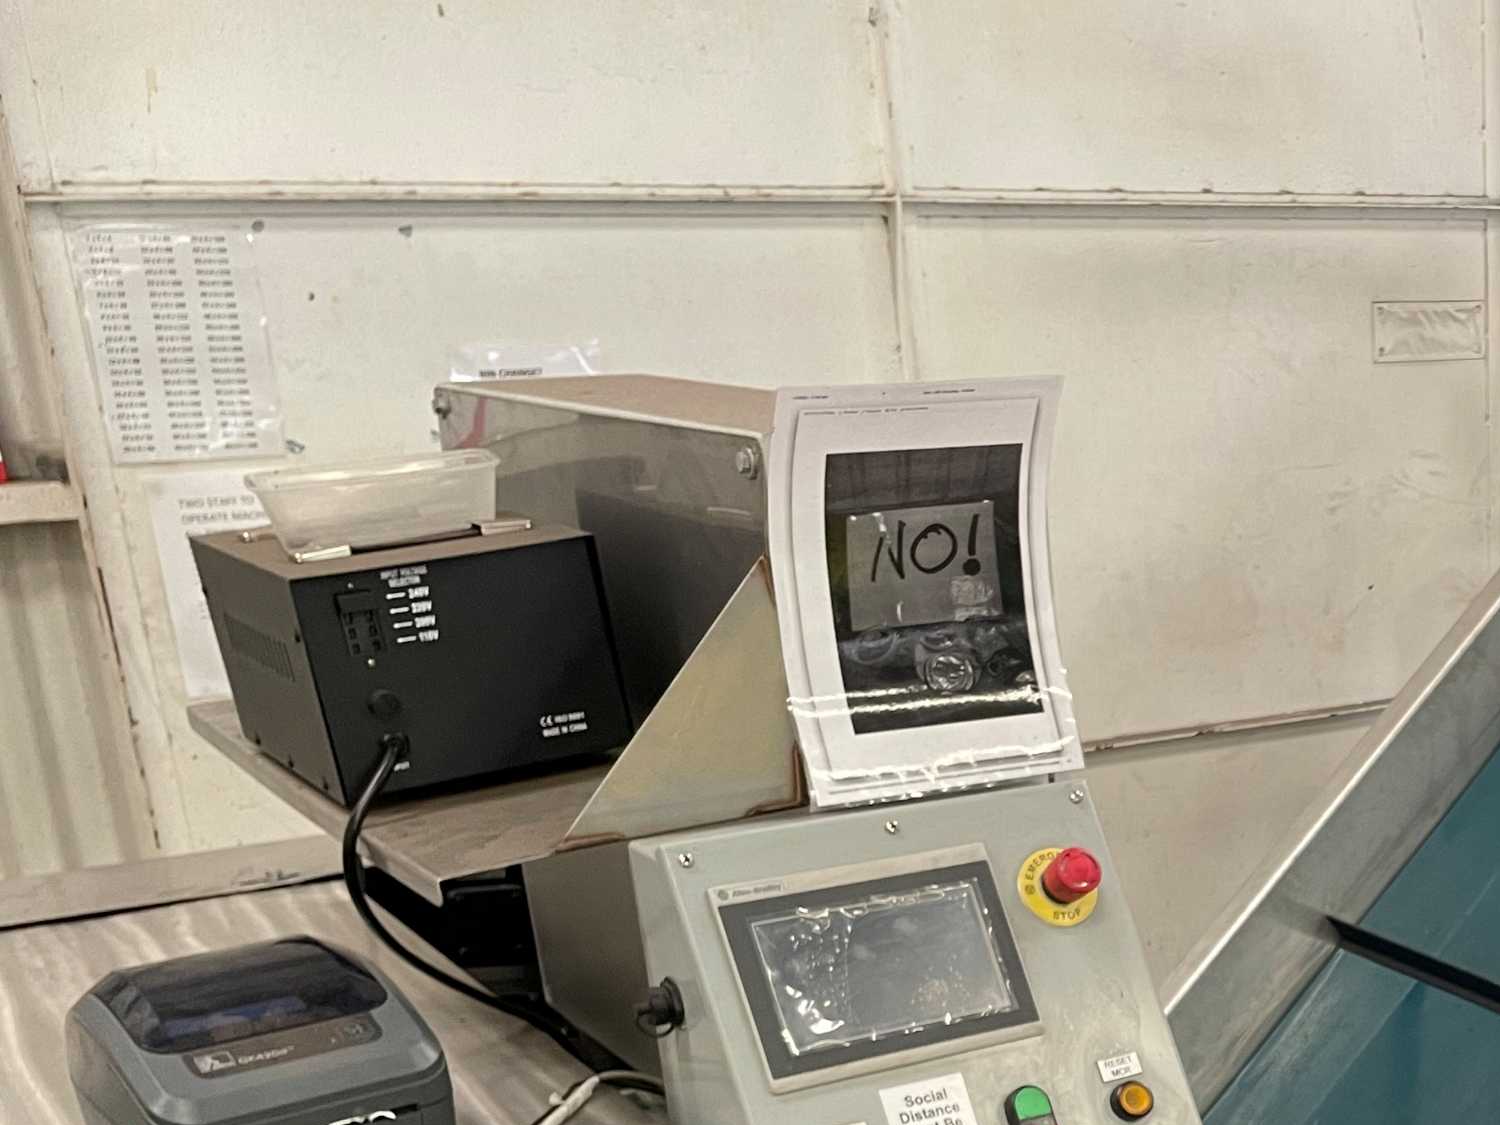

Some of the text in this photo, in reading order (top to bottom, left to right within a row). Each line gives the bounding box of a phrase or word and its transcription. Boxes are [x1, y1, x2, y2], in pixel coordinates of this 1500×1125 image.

[871, 513, 981, 582] NO!
[1053, 907, 1081, 920] STOP
[904, 1088, 948, 1108] Social
[899, 1103, 960, 1125] Distance
